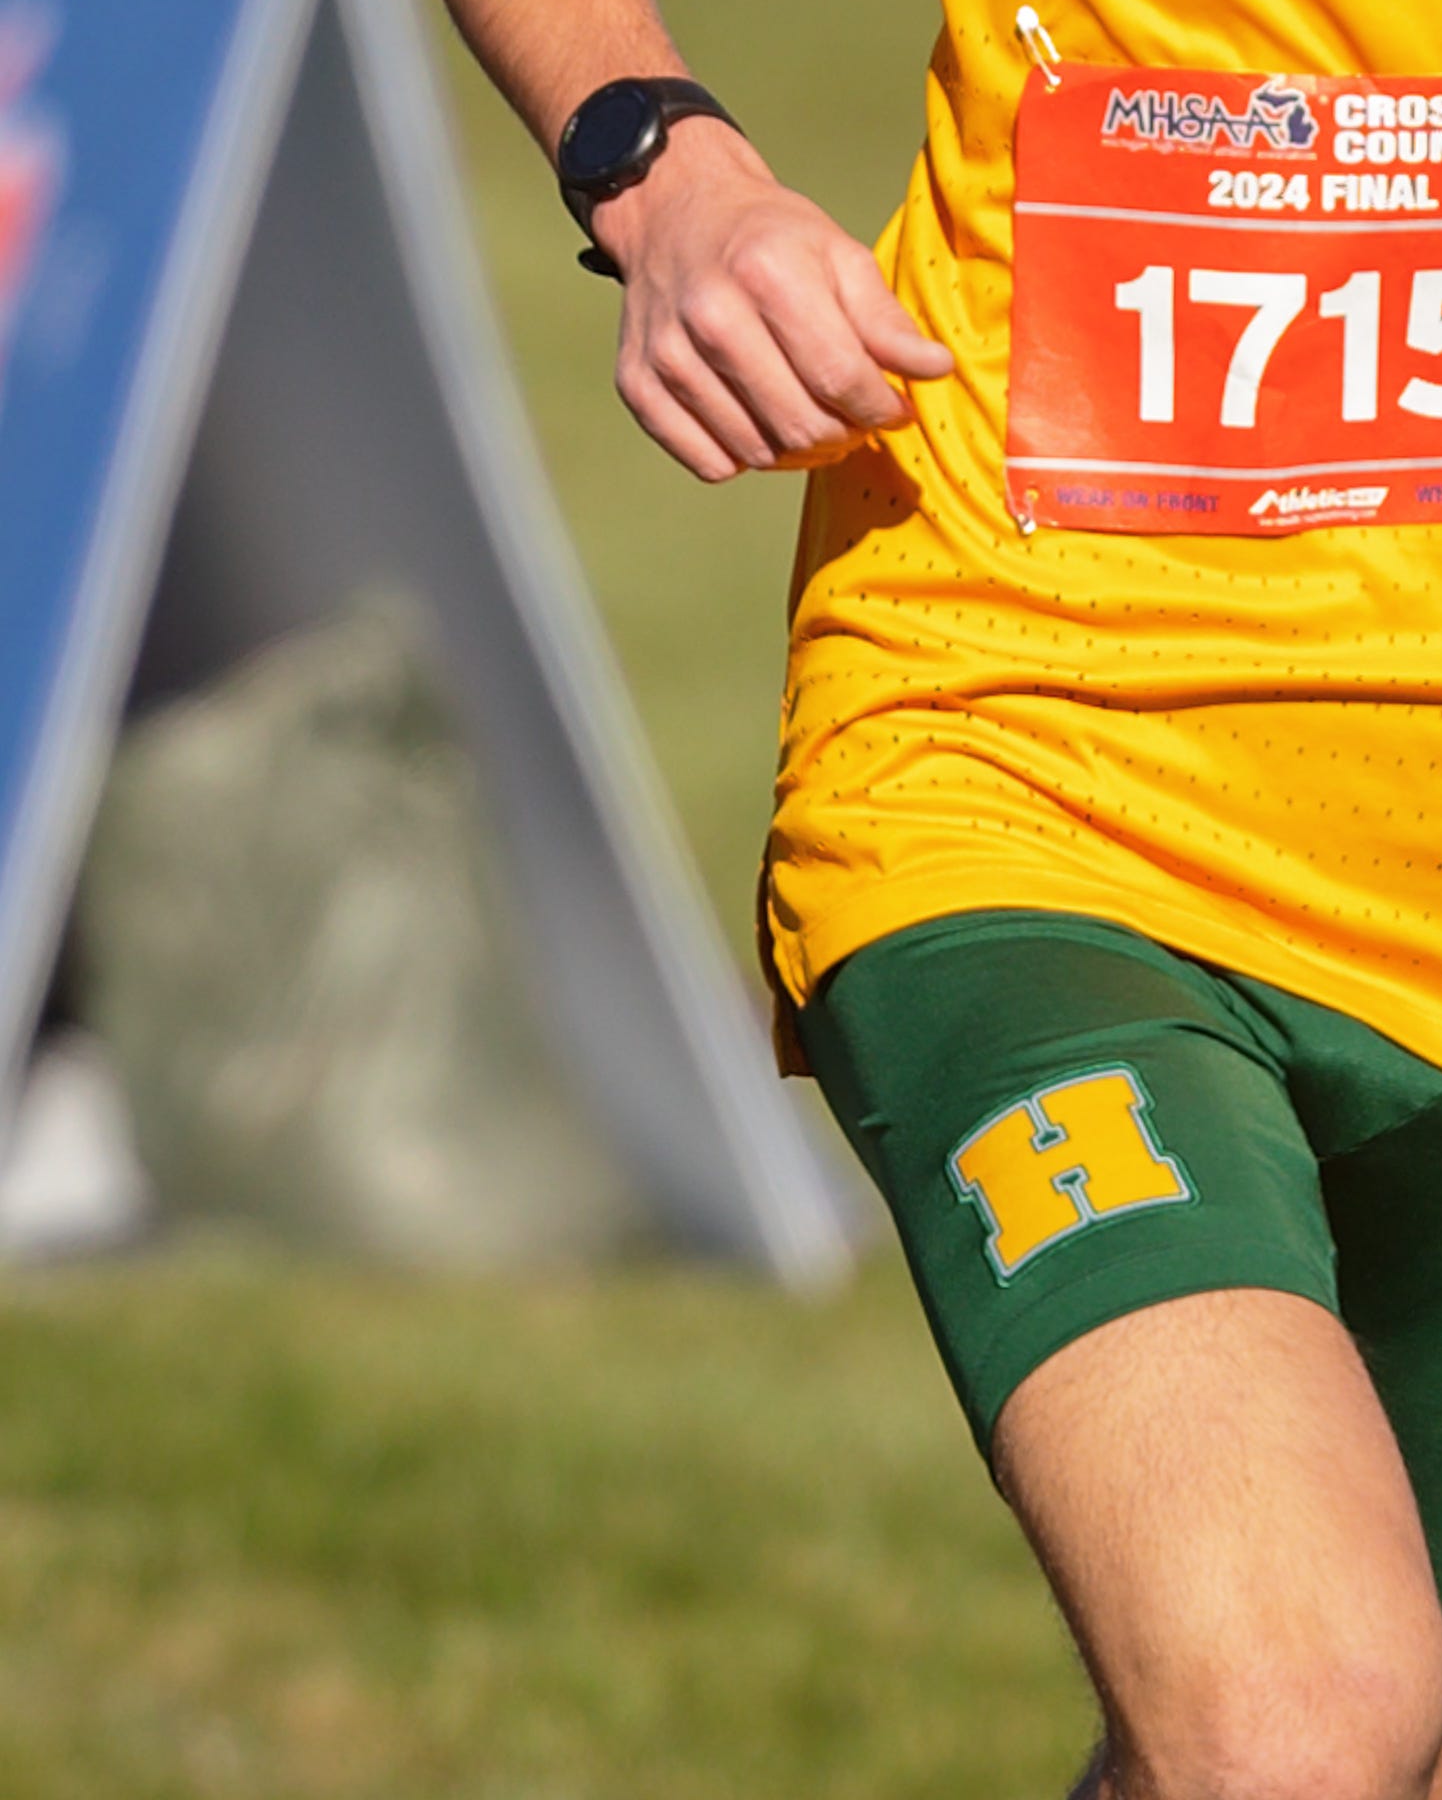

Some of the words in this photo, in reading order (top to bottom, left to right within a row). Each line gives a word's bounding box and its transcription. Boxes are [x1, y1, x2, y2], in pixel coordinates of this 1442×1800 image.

[1101, 88, 1288, 146] MHSAA
[1208, 170, 1310, 211] 2024
[1321, 173, 1439, 211] FINAL
[1157, 492, 1220, 512] FRONT
[945, 1061, 1199, 1287] H
